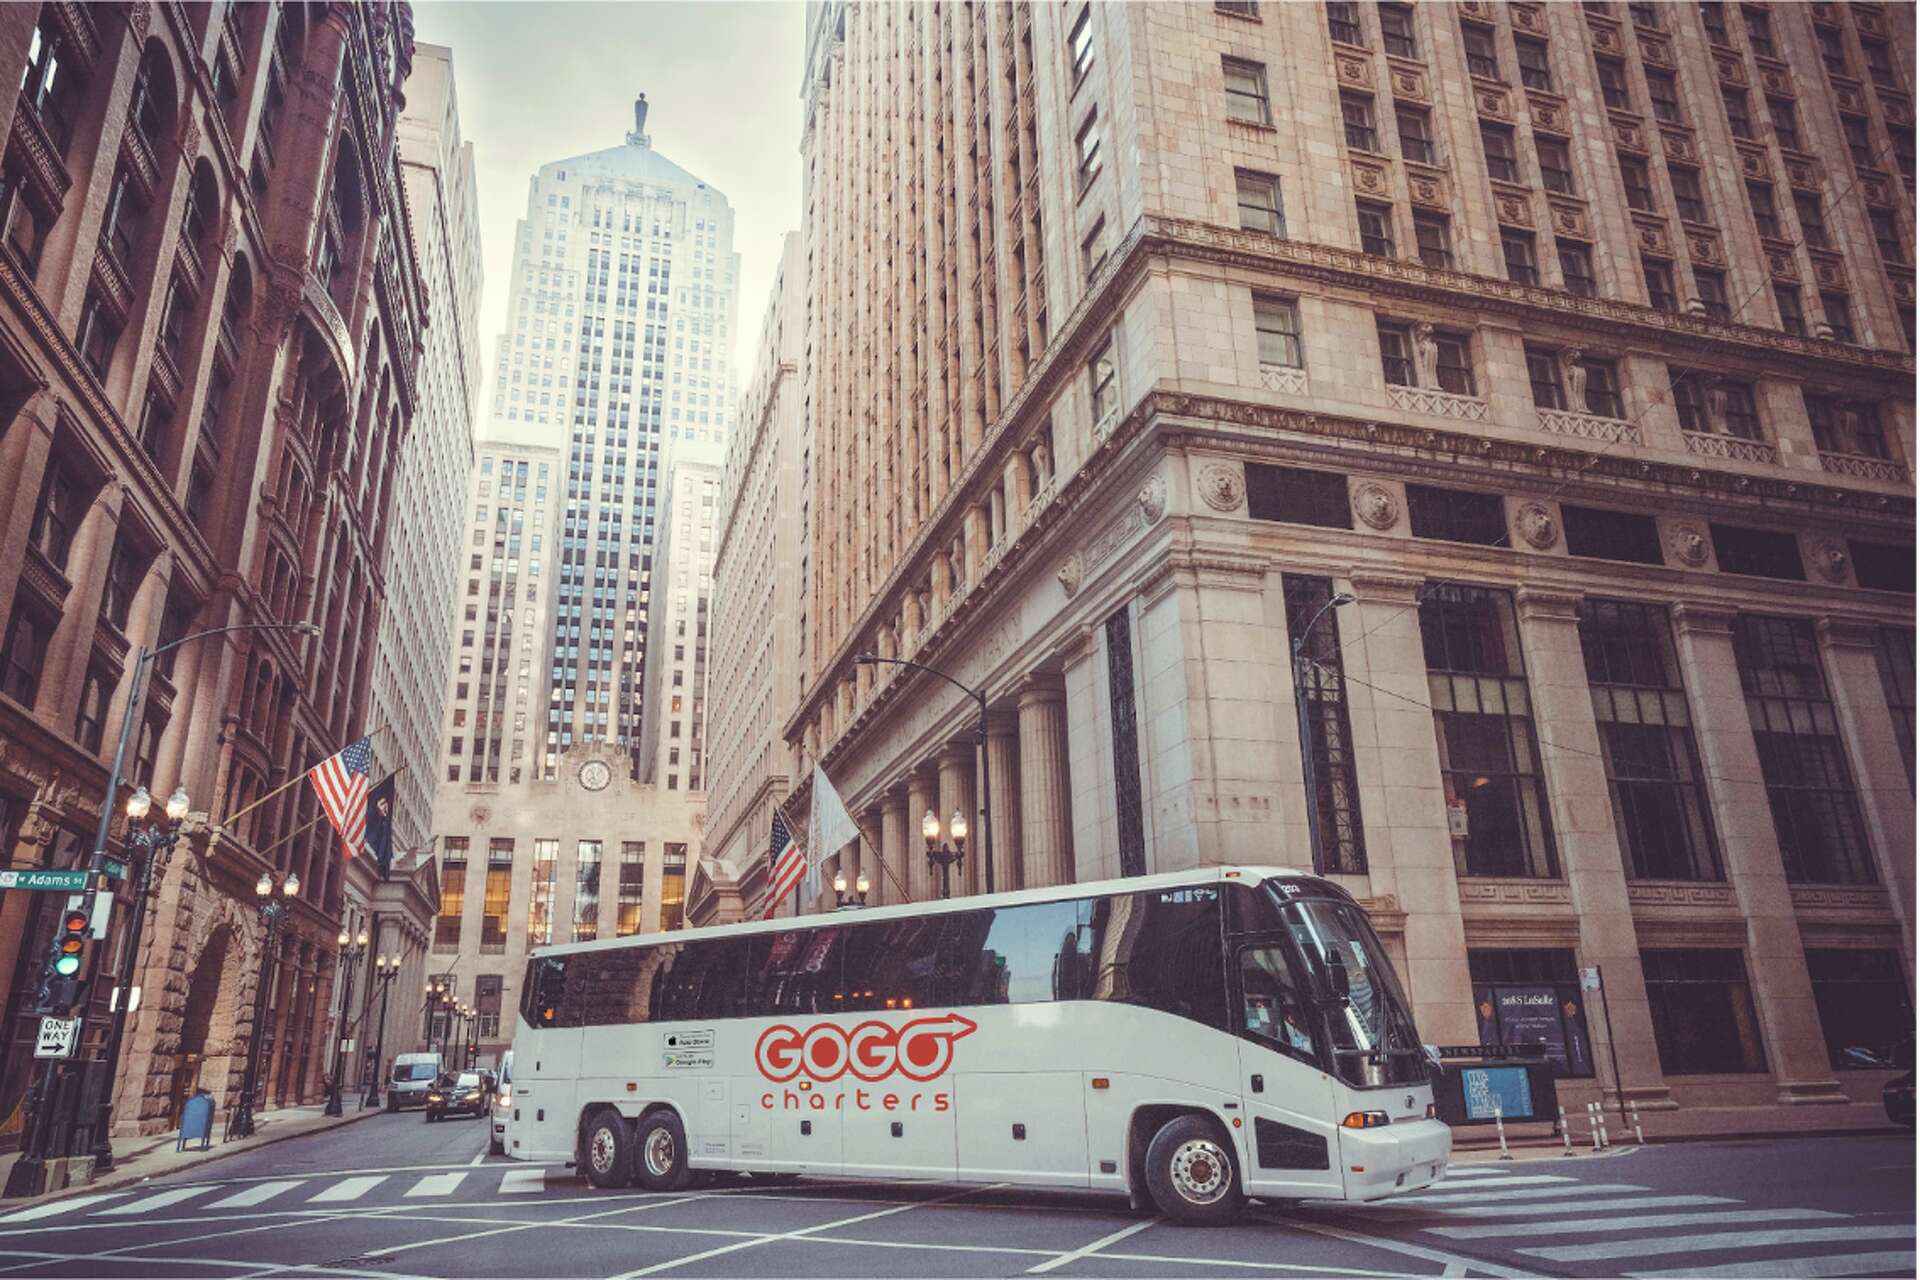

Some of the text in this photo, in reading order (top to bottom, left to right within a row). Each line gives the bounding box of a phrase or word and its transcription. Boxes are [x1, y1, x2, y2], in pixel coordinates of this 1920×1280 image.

[28, 874, 70, 886] Adams
[45, 1021, 70, 1030] ONE
[43, 1032, 69, 1041] WAY
[755, 1013, 977, 1083] GOGO
[761, 1088, 949, 1111] charters
